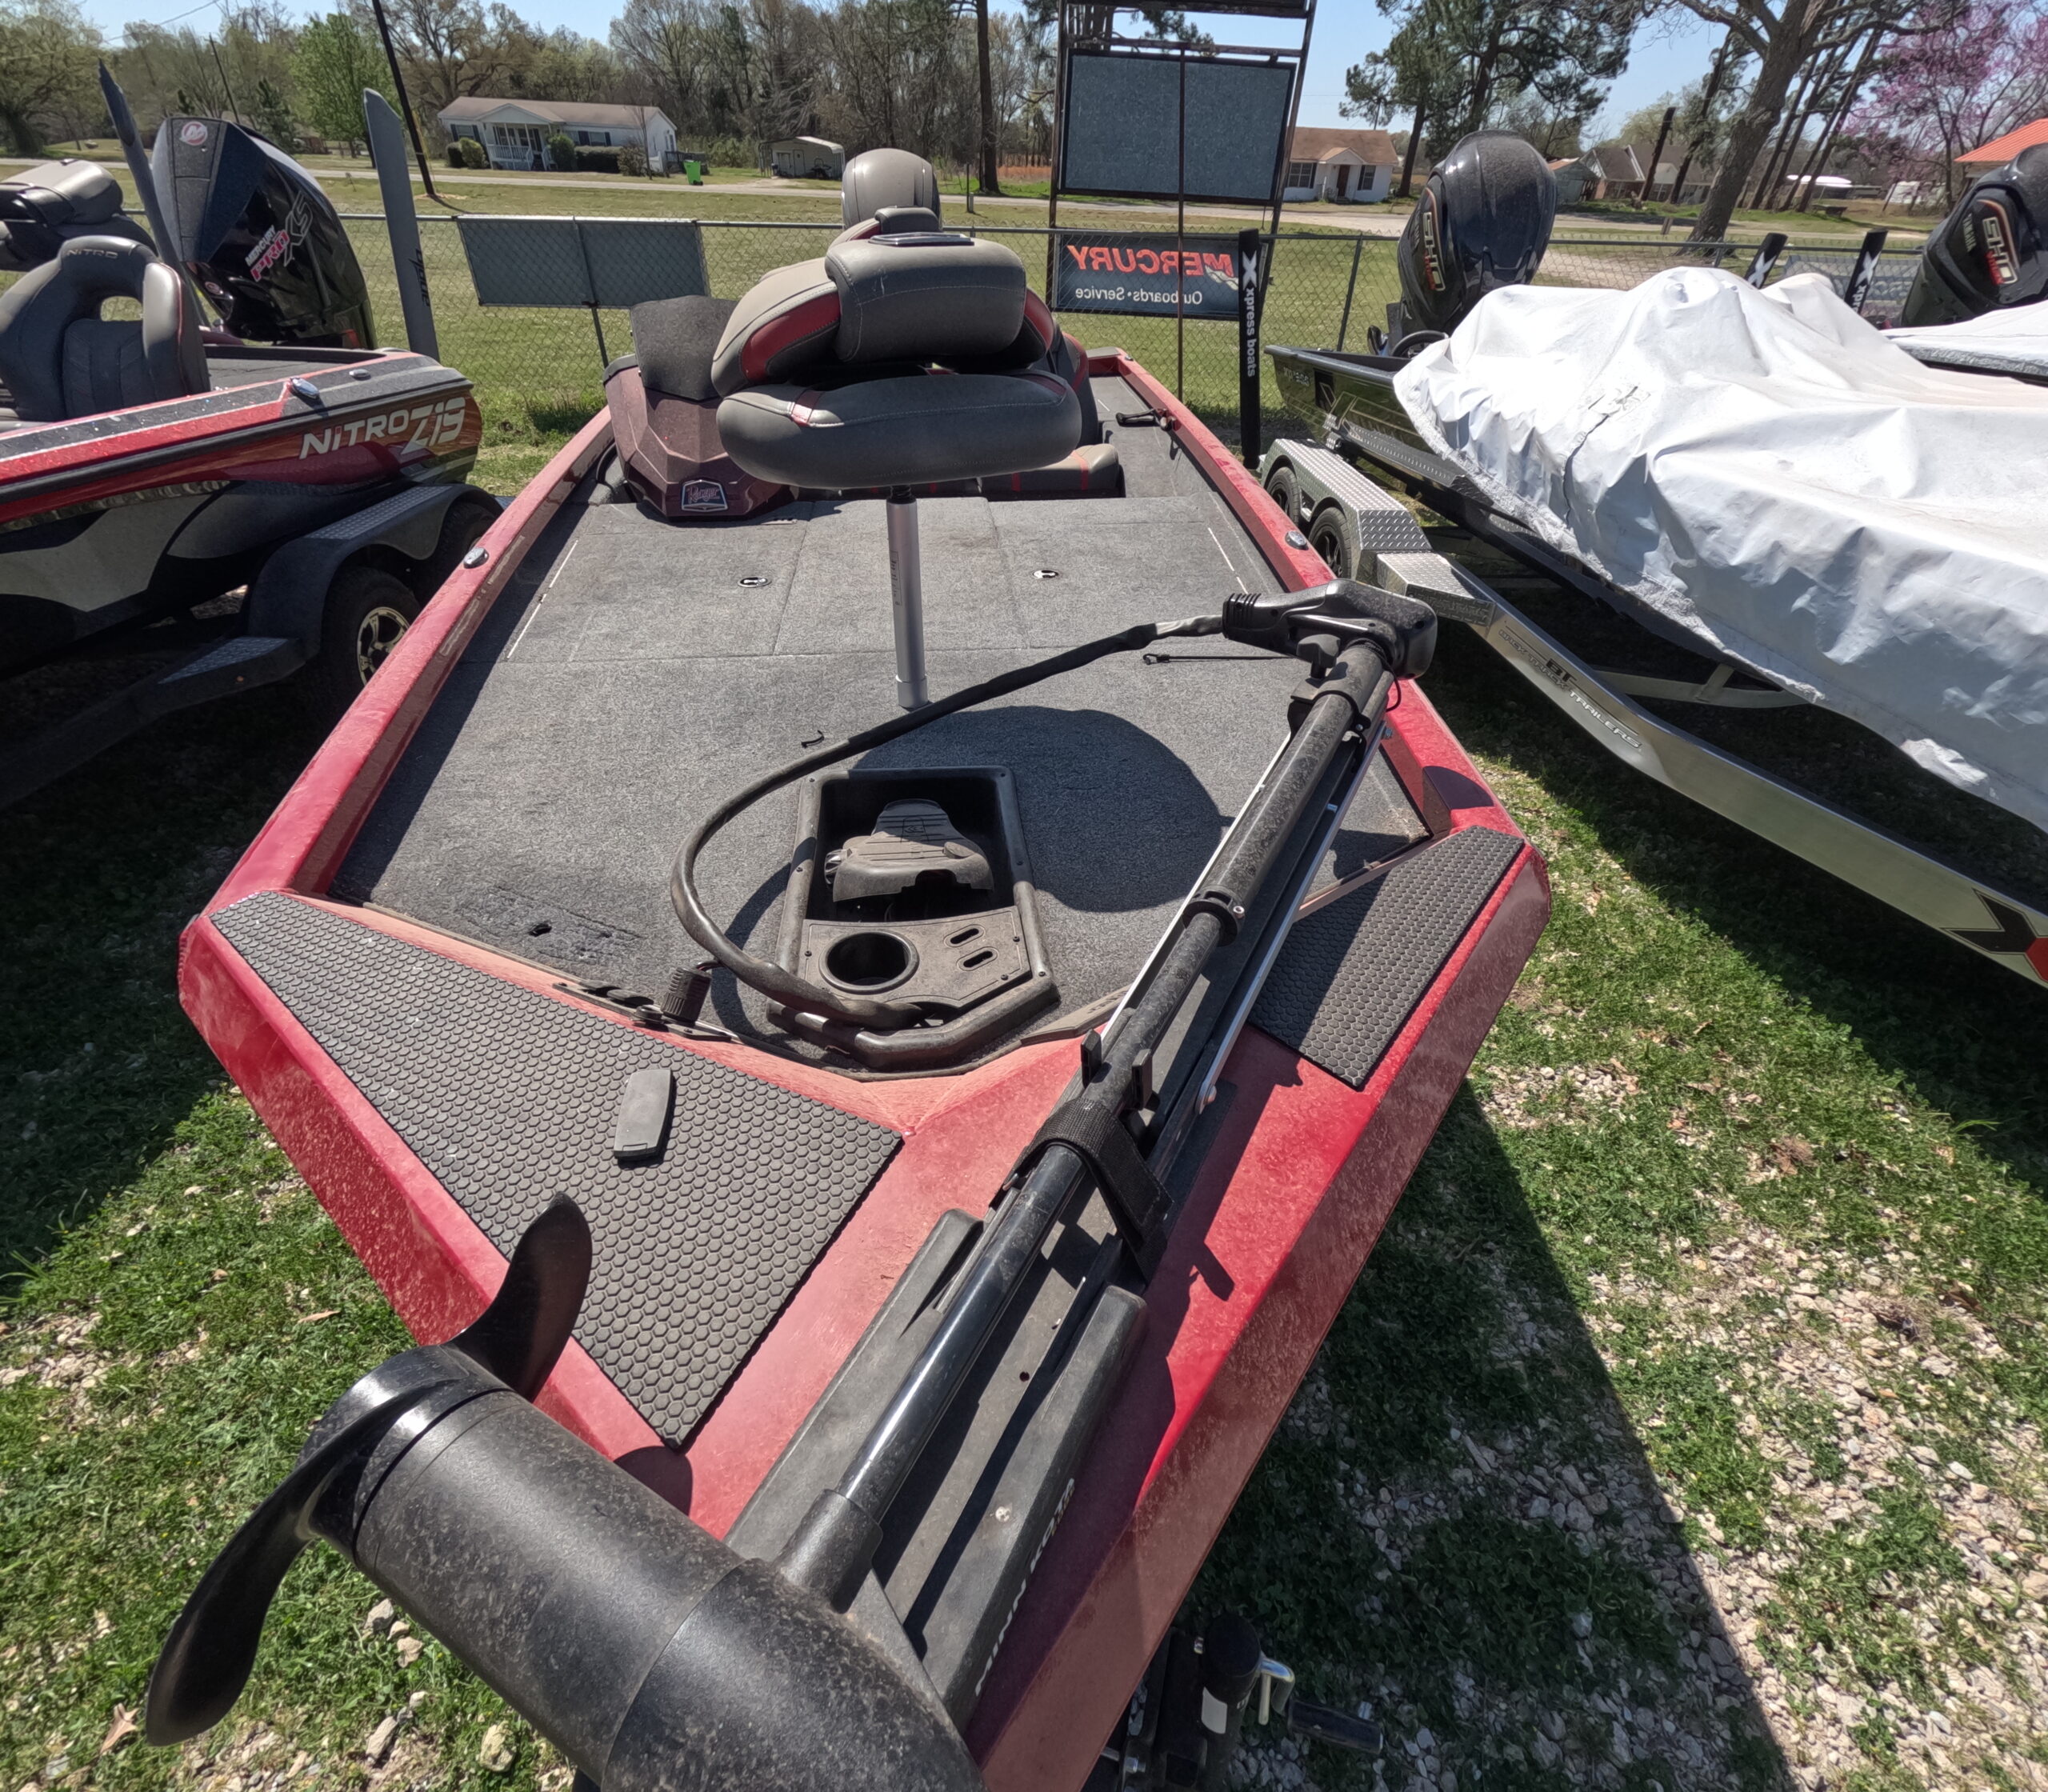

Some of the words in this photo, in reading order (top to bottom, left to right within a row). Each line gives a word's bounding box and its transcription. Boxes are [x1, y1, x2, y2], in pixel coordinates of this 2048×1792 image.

[244, 224, 276, 267] MERCURY
[250, 229, 290, 282] PRO
[1247, 338, 1257, 378] boats
[400, 397, 466, 454] Z19
[1546, 658, 1578, 682] BT
[1569, 688, 1642, 750] TRAILERS
